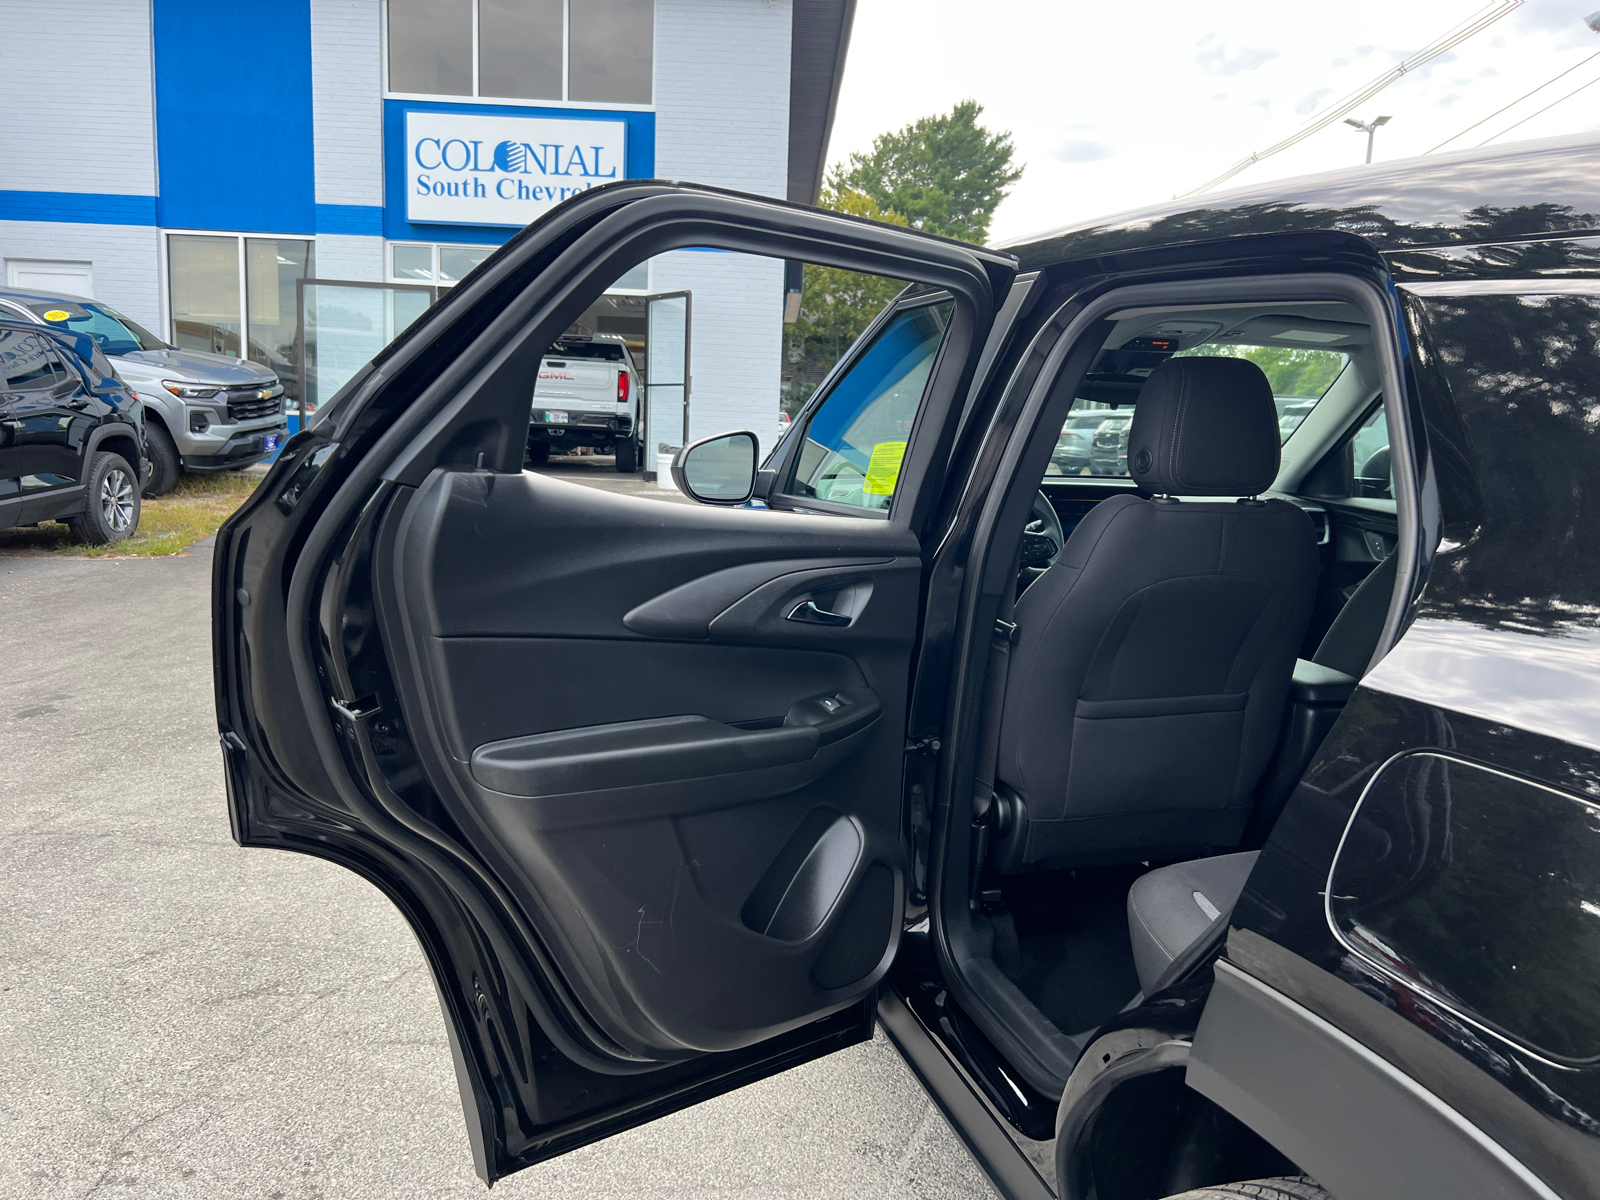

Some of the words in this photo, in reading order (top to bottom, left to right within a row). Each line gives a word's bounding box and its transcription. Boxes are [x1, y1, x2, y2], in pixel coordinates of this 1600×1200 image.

[415, 137, 617, 178] COLONIAL
[416, 174, 487, 199] South
[538, 371, 575, 380] GMC
